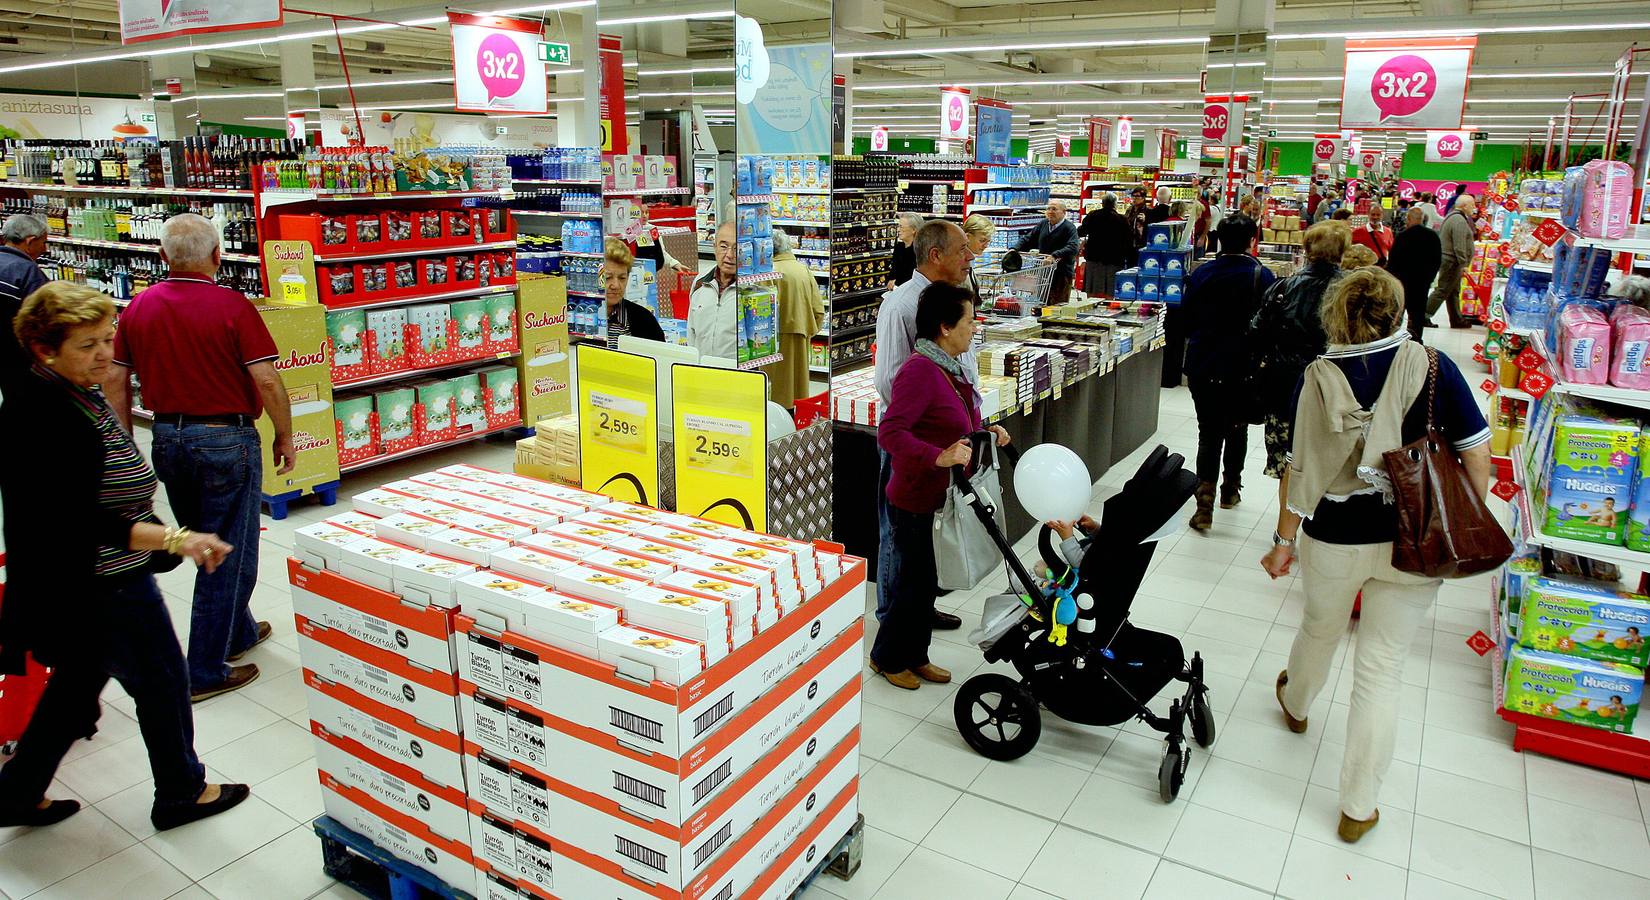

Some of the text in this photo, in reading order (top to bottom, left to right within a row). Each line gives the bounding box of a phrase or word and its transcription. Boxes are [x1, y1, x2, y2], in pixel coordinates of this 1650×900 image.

[482, 49, 520, 80] 3x2
[1378, 71, 1429, 99] 3x2
[1439, 140, 1460, 151] 3x2
[273, 244, 304, 260] Suchard
[524, 305, 567, 329] Suchard
[275, 341, 327, 370] uchard
[600, 412, 638, 436] 2,59€
[695, 435, 740, 458] 2,59€
[1568, 439, 1612, 449] Protección
[1565, 478, 1617, 495] HUGGIES
[1537, 600, 1590, 617] Protección
[470, 651, 490, 665] Turrón
[471, 658, 492, 671] Blando
[1520, 667, 1572, 683] Protección
[1582, 675, 1632, 693] HUGGIES
[476, 712, 496, 726] Turrón
[476, 718, 497, 732] Blando
[480, 772, 500, 786] Turrón
[480, 779, 501, 792] Blando
[484, 832, 504, 847] Turrón
[484, 838, 505, 852] Blando
